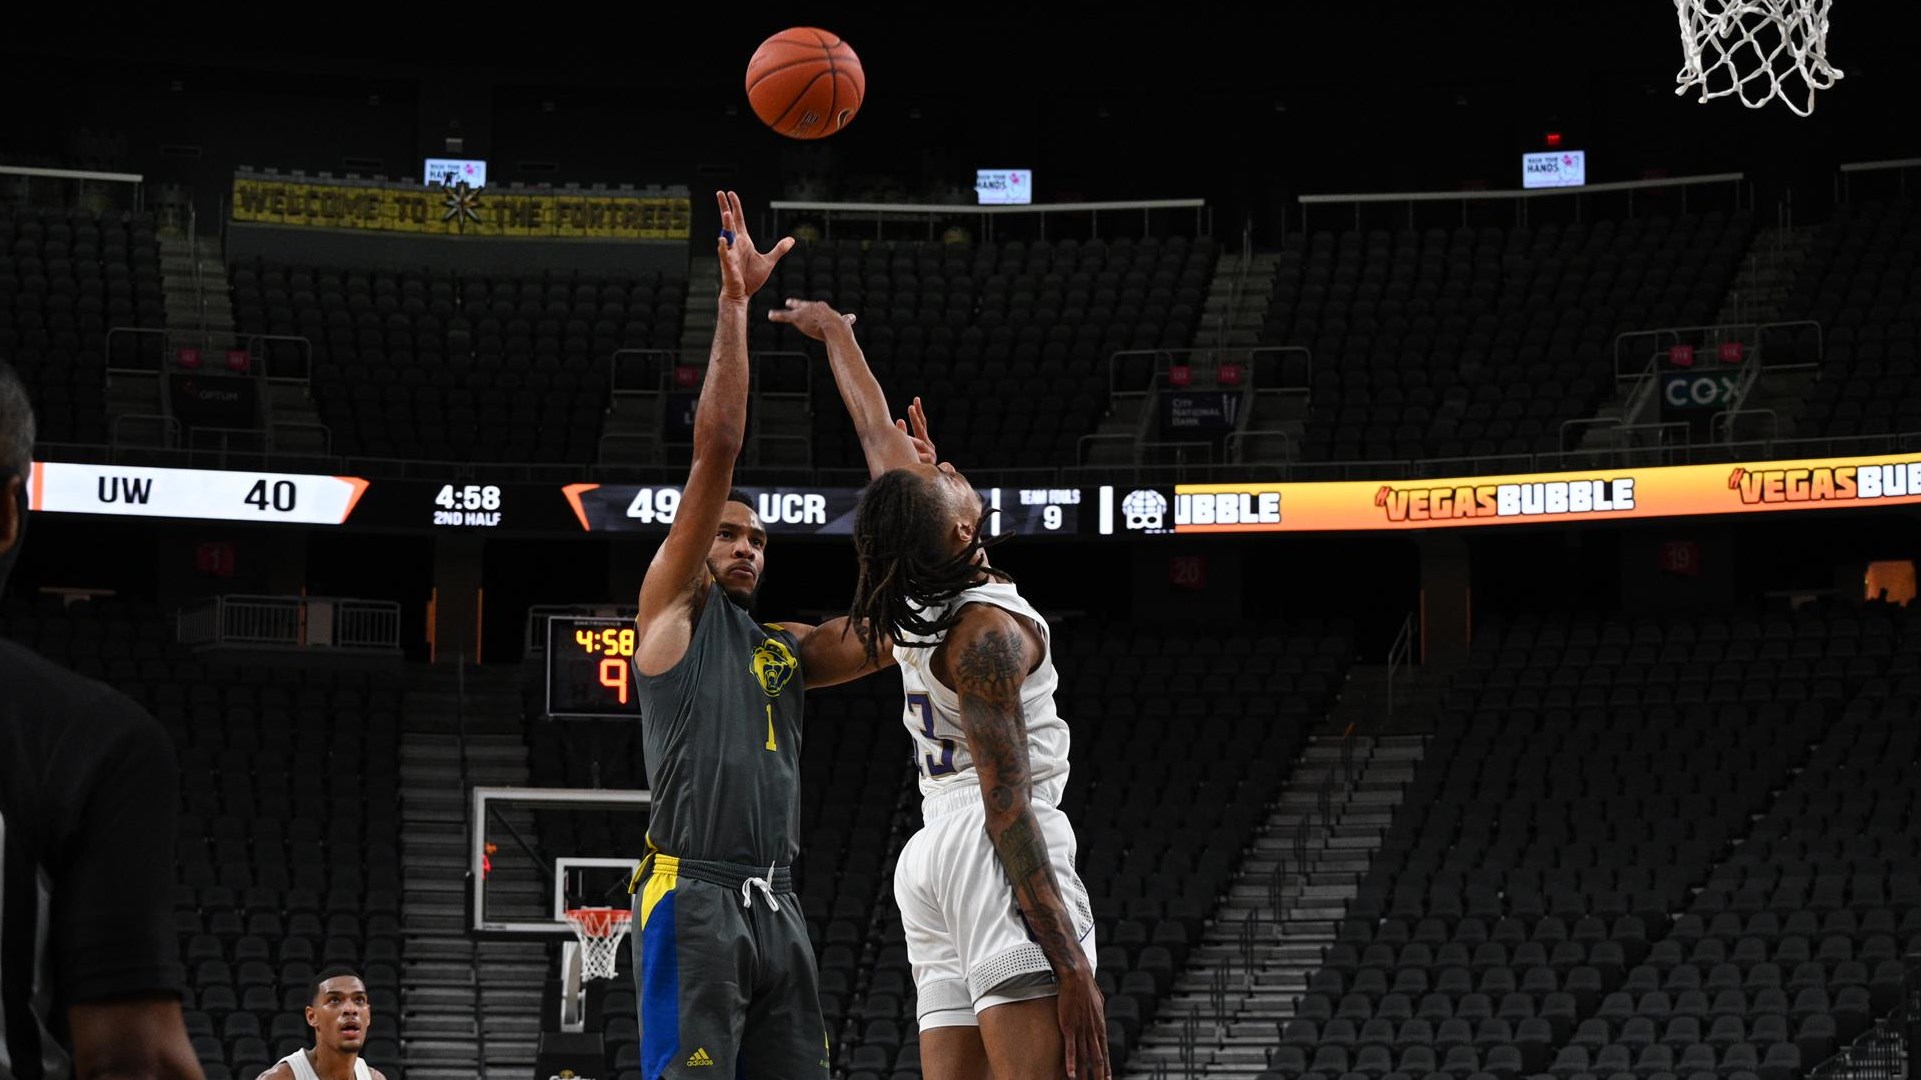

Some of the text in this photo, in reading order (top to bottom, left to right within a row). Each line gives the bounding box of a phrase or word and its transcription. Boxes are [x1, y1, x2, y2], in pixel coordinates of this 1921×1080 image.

[1527, 164, 1559, 173] HANDS
[239, 184, 689, 230] WELCOME TO THE FORTRESS
[98, 476, 296, 512] UW 40
[435, 484, 501, 510] 4:58
[626, 488, 827, 524] 49 UCR
[433, 511, 502, 526] 2ND HALF
[1043, 505, 1063, 530] 9
[1668, 546, 1689, 570] 19
[1173, 561, 1200, 584] 20
[576, 628, 634, 656] 4:58
[600, 658, 628, 704] 9
[765, 704, 777, 752] 1
[687, 1059, 714, 1067] adidas
